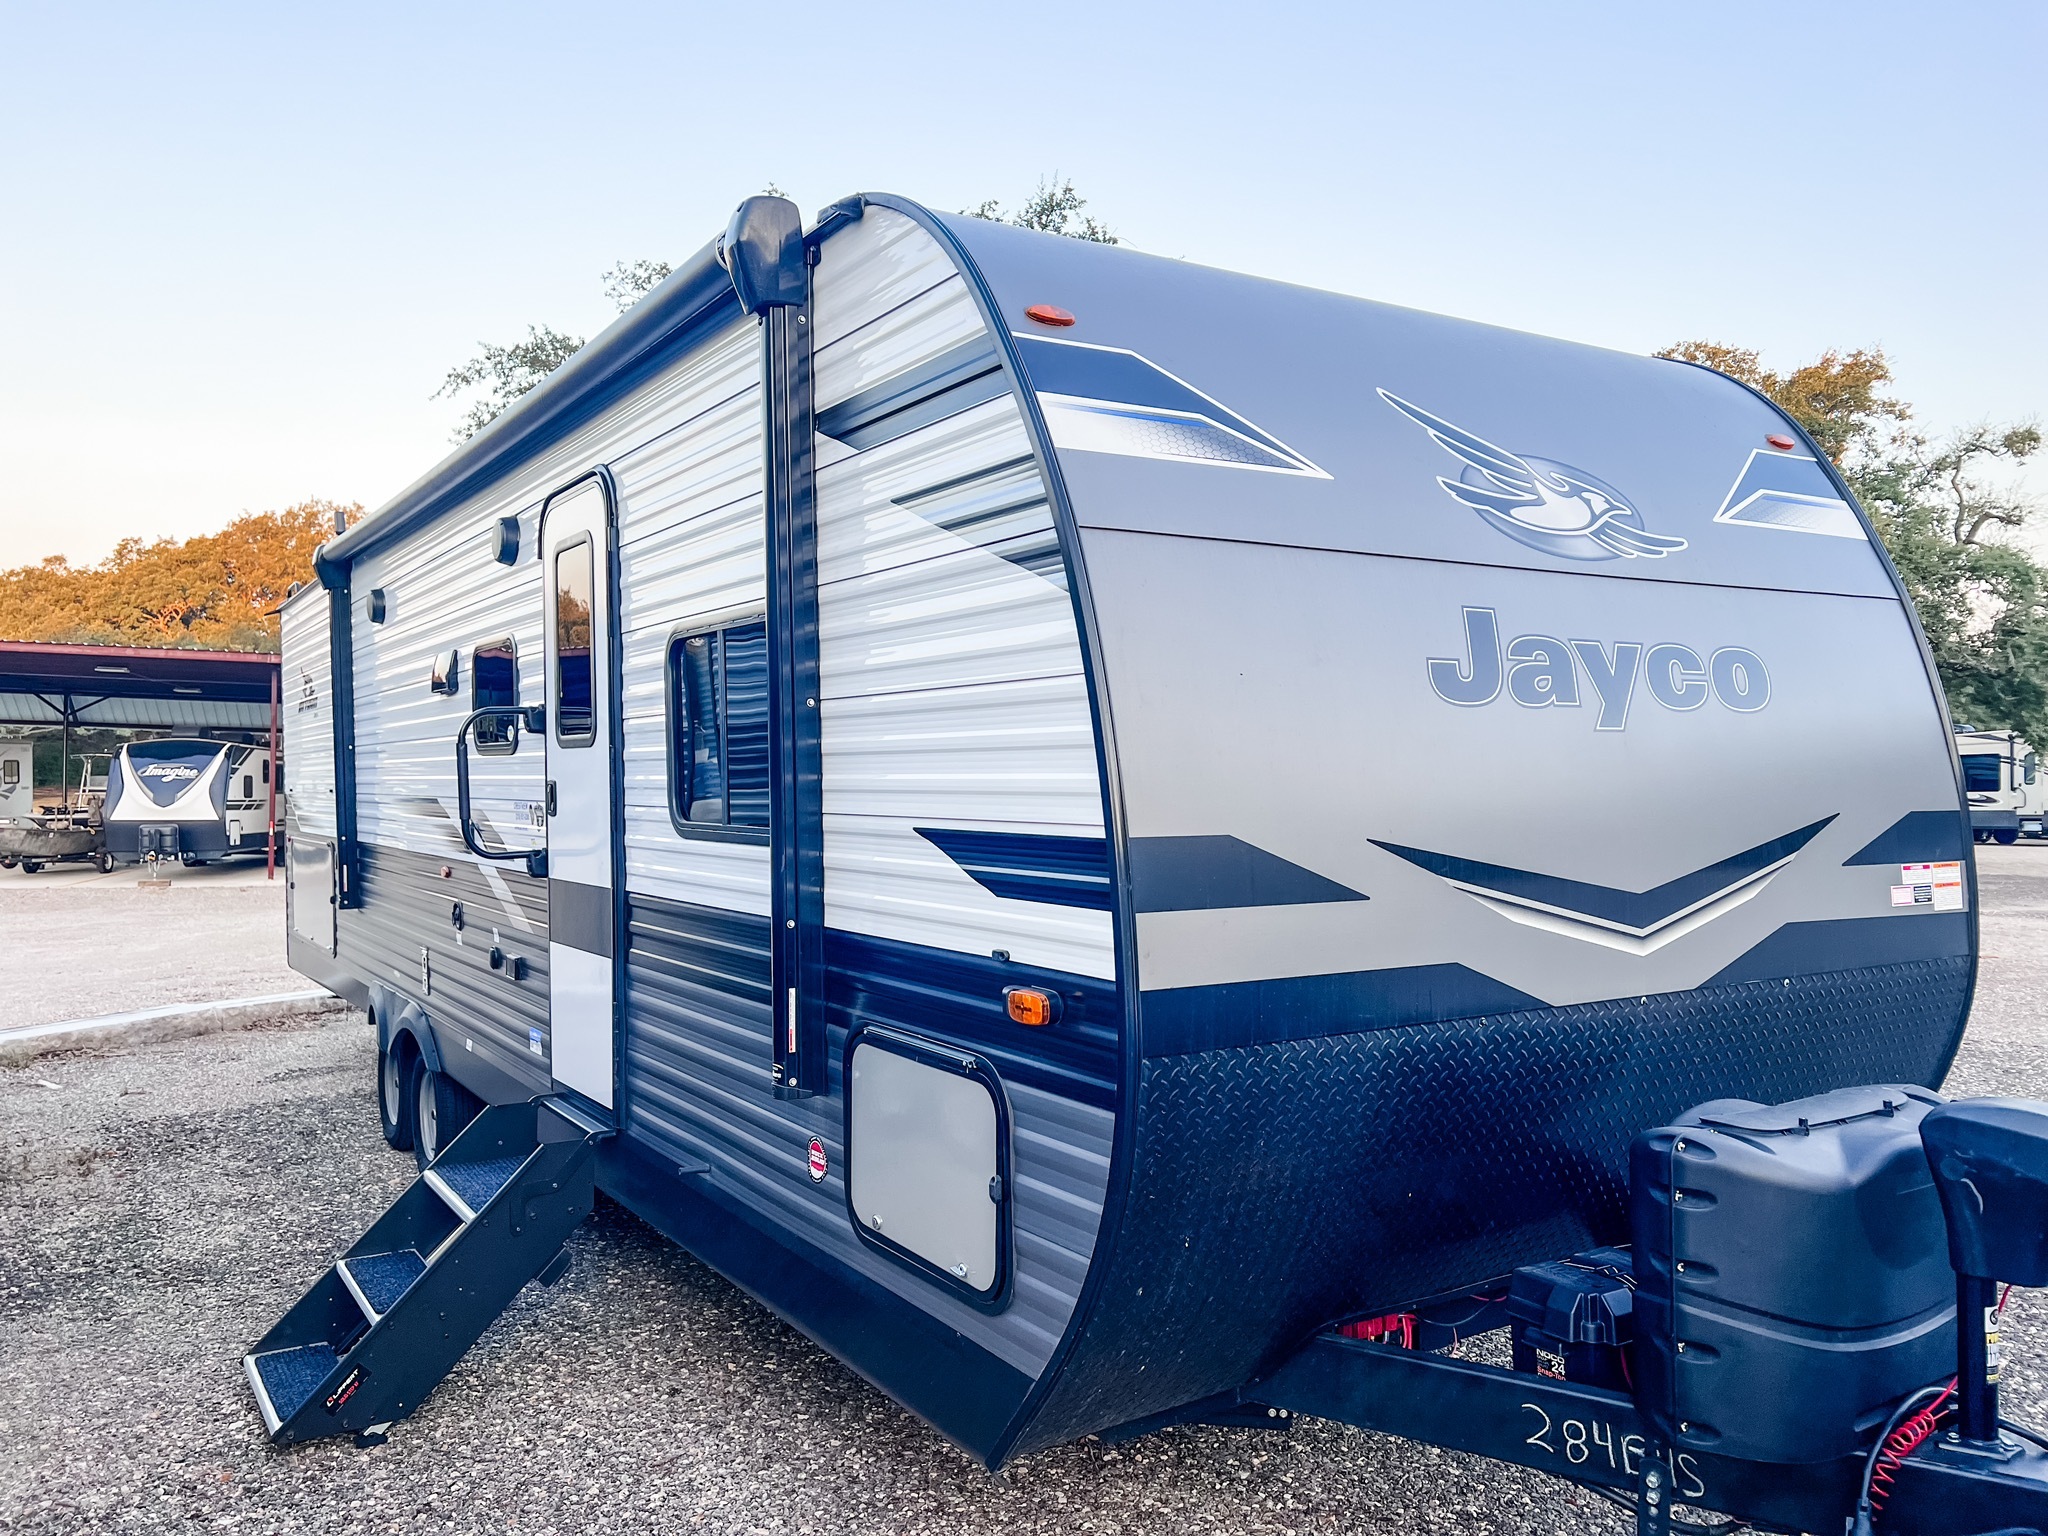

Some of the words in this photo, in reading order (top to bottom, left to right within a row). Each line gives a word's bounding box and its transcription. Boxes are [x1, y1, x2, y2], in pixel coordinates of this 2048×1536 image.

[1426, 605, 1772, 732] Jayco
[142, 763, 199, 782] Imagine
[1536, 1348, 1565, 1365] NOCO
[1551, 1361, 1566, 1376] 24
